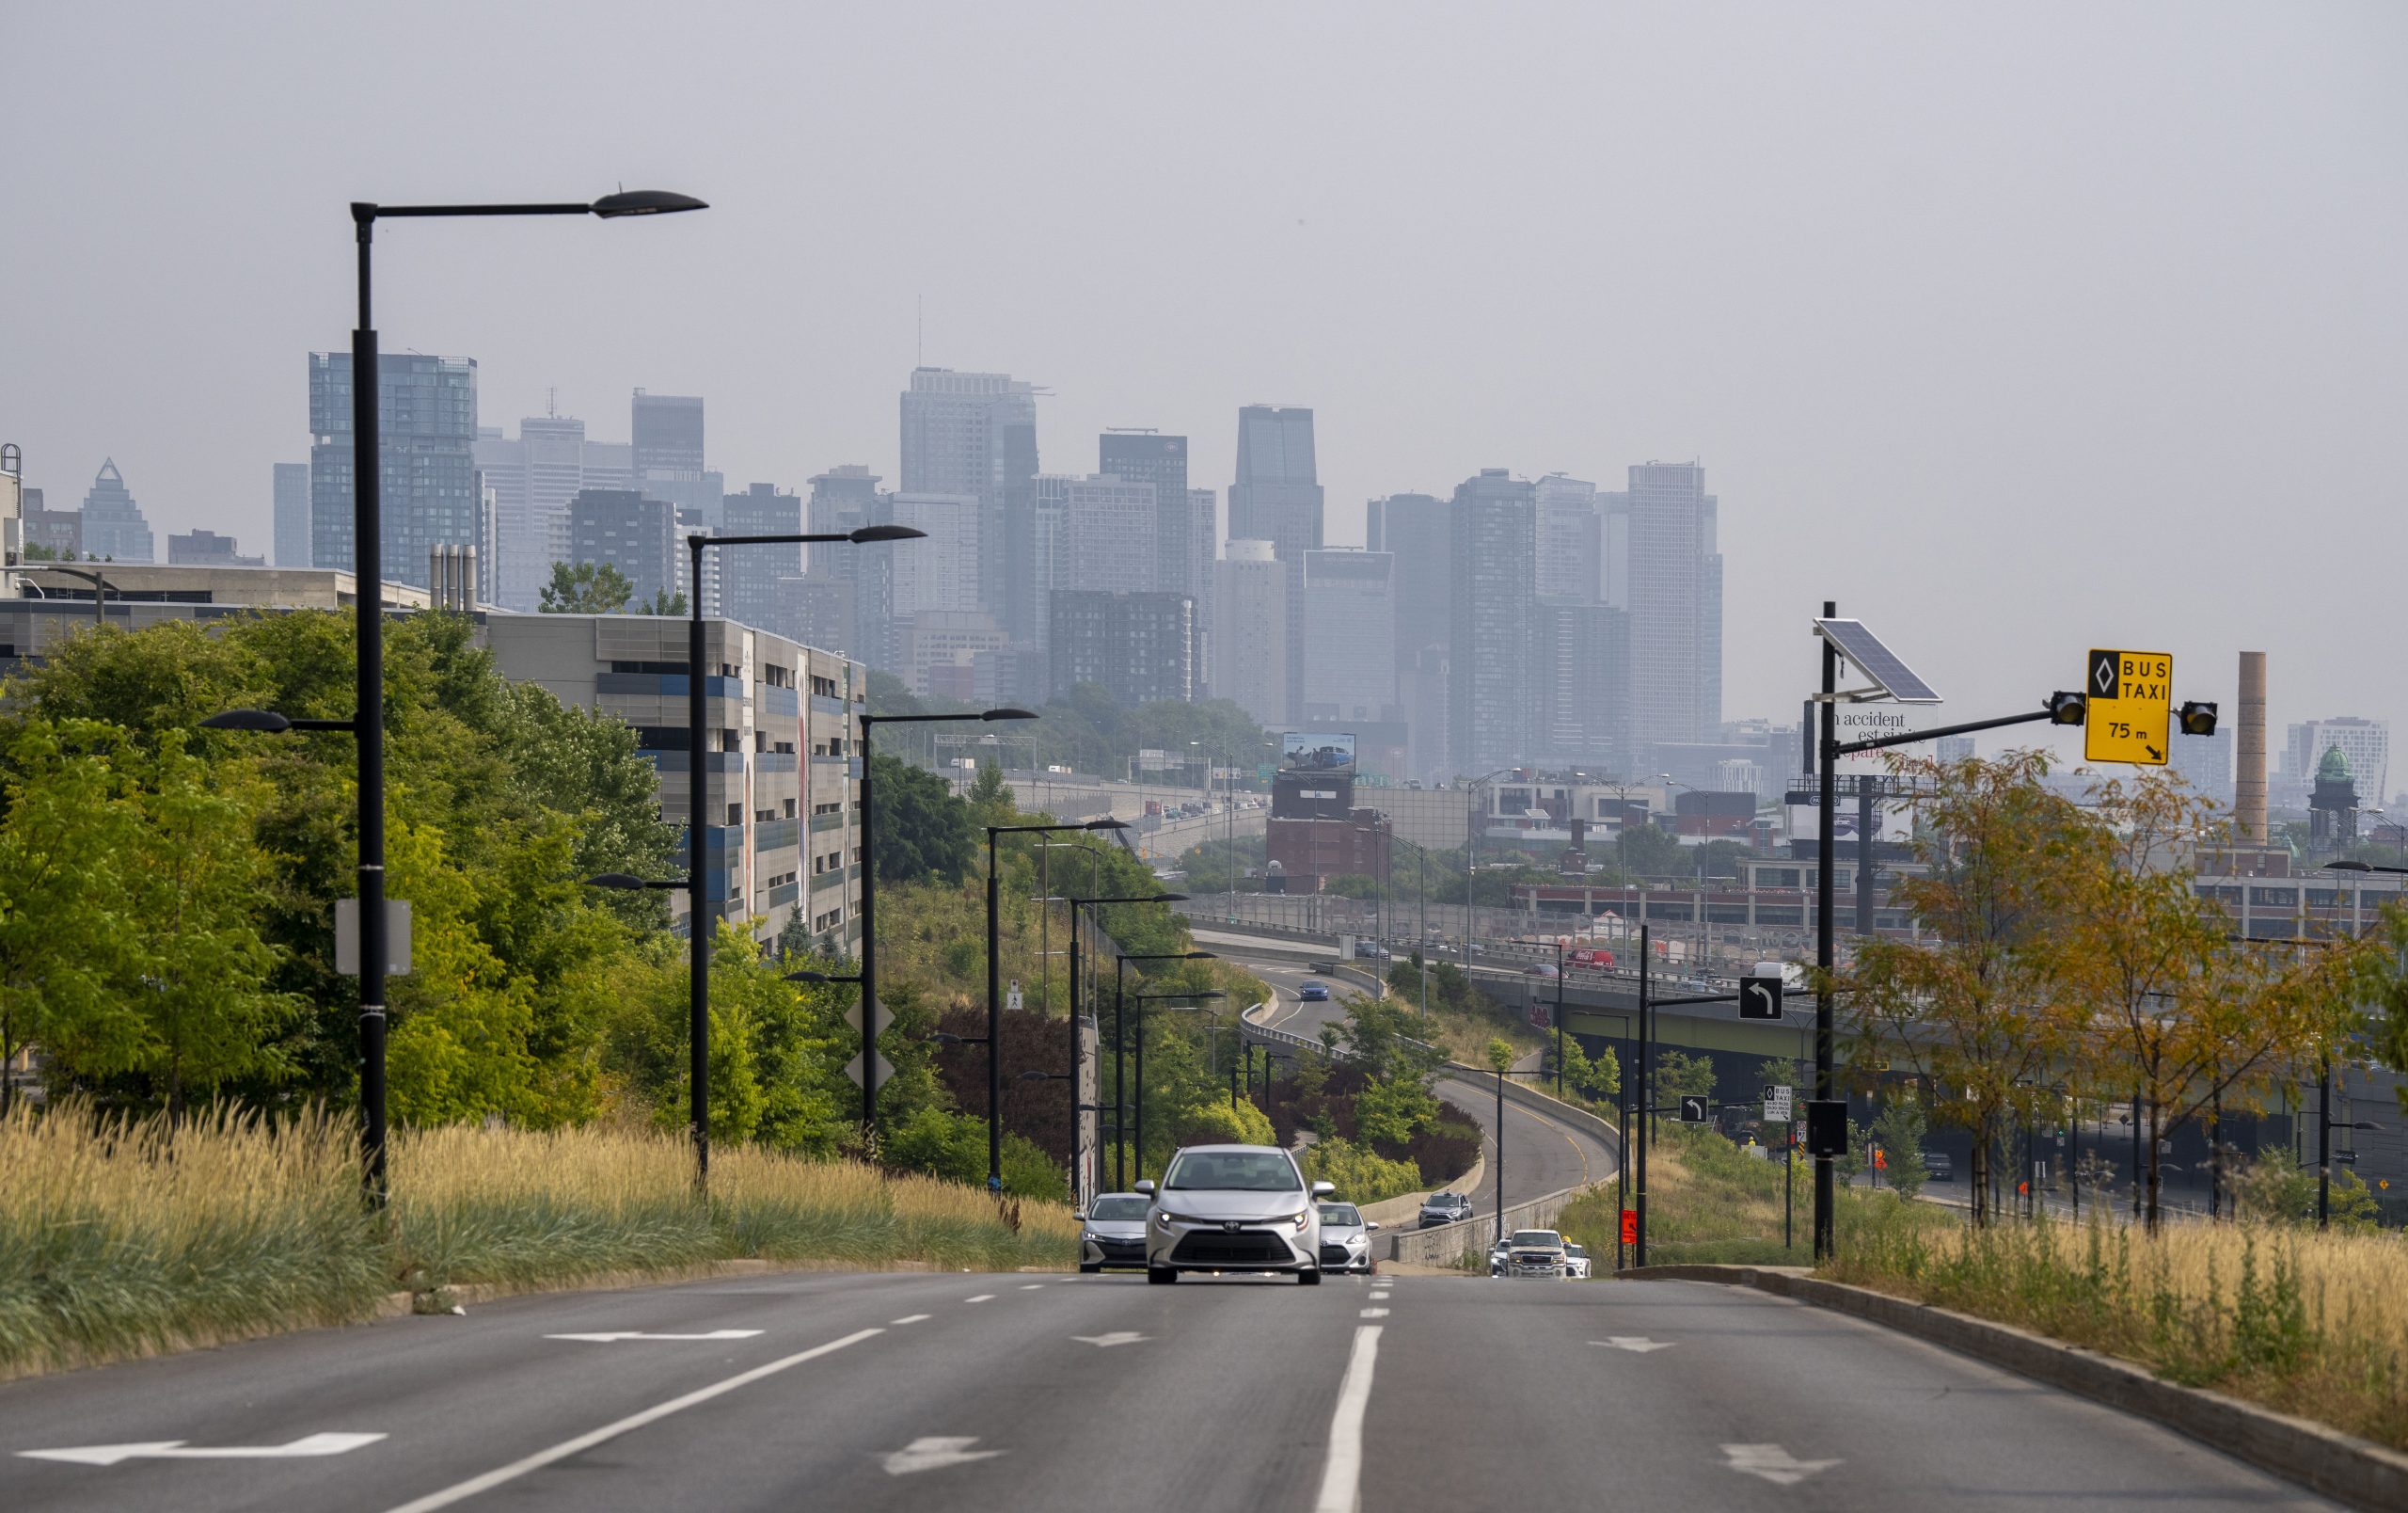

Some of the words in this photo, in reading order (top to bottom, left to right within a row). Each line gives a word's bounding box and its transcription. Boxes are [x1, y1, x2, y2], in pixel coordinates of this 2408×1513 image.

[2123, 661, 2166, 677] BUS
[2123, 683, 2165, 700] TAXI
[1844, 712, 1905, 726] accident
[1858, 728, 1879, 743] est
[2108, 722, 2131, 739] 75
[2135, 731, 2147, 740] m
